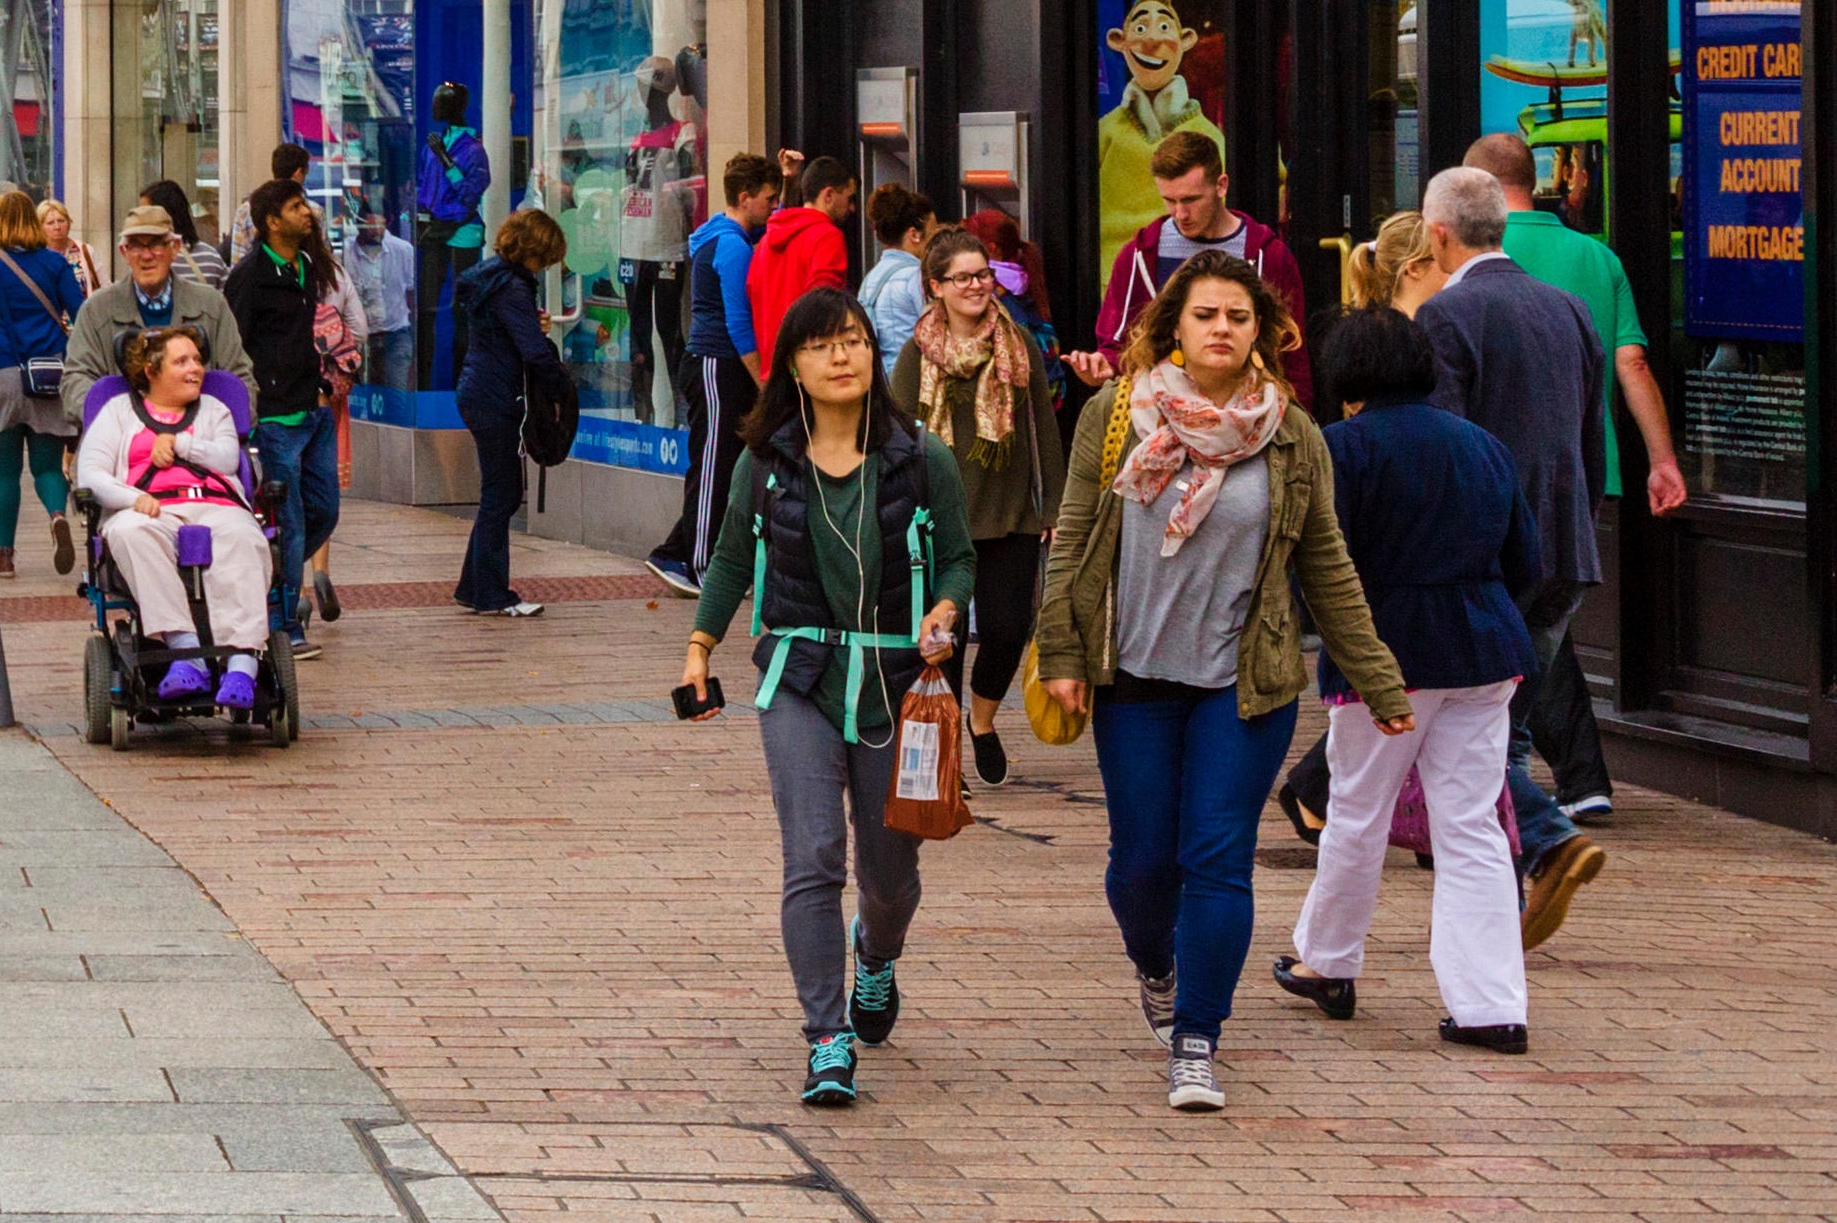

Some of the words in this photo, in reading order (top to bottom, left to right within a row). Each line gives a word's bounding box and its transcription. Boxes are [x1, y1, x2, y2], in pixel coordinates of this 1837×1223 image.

[1696, 44, 1757, 80] CREDIT
[1720, 111, 1801, 146] CURRENT
[1720, 159, 1802, 193] ACCOUNT
[1708, 225, 1805, 261] MORTGAGE
